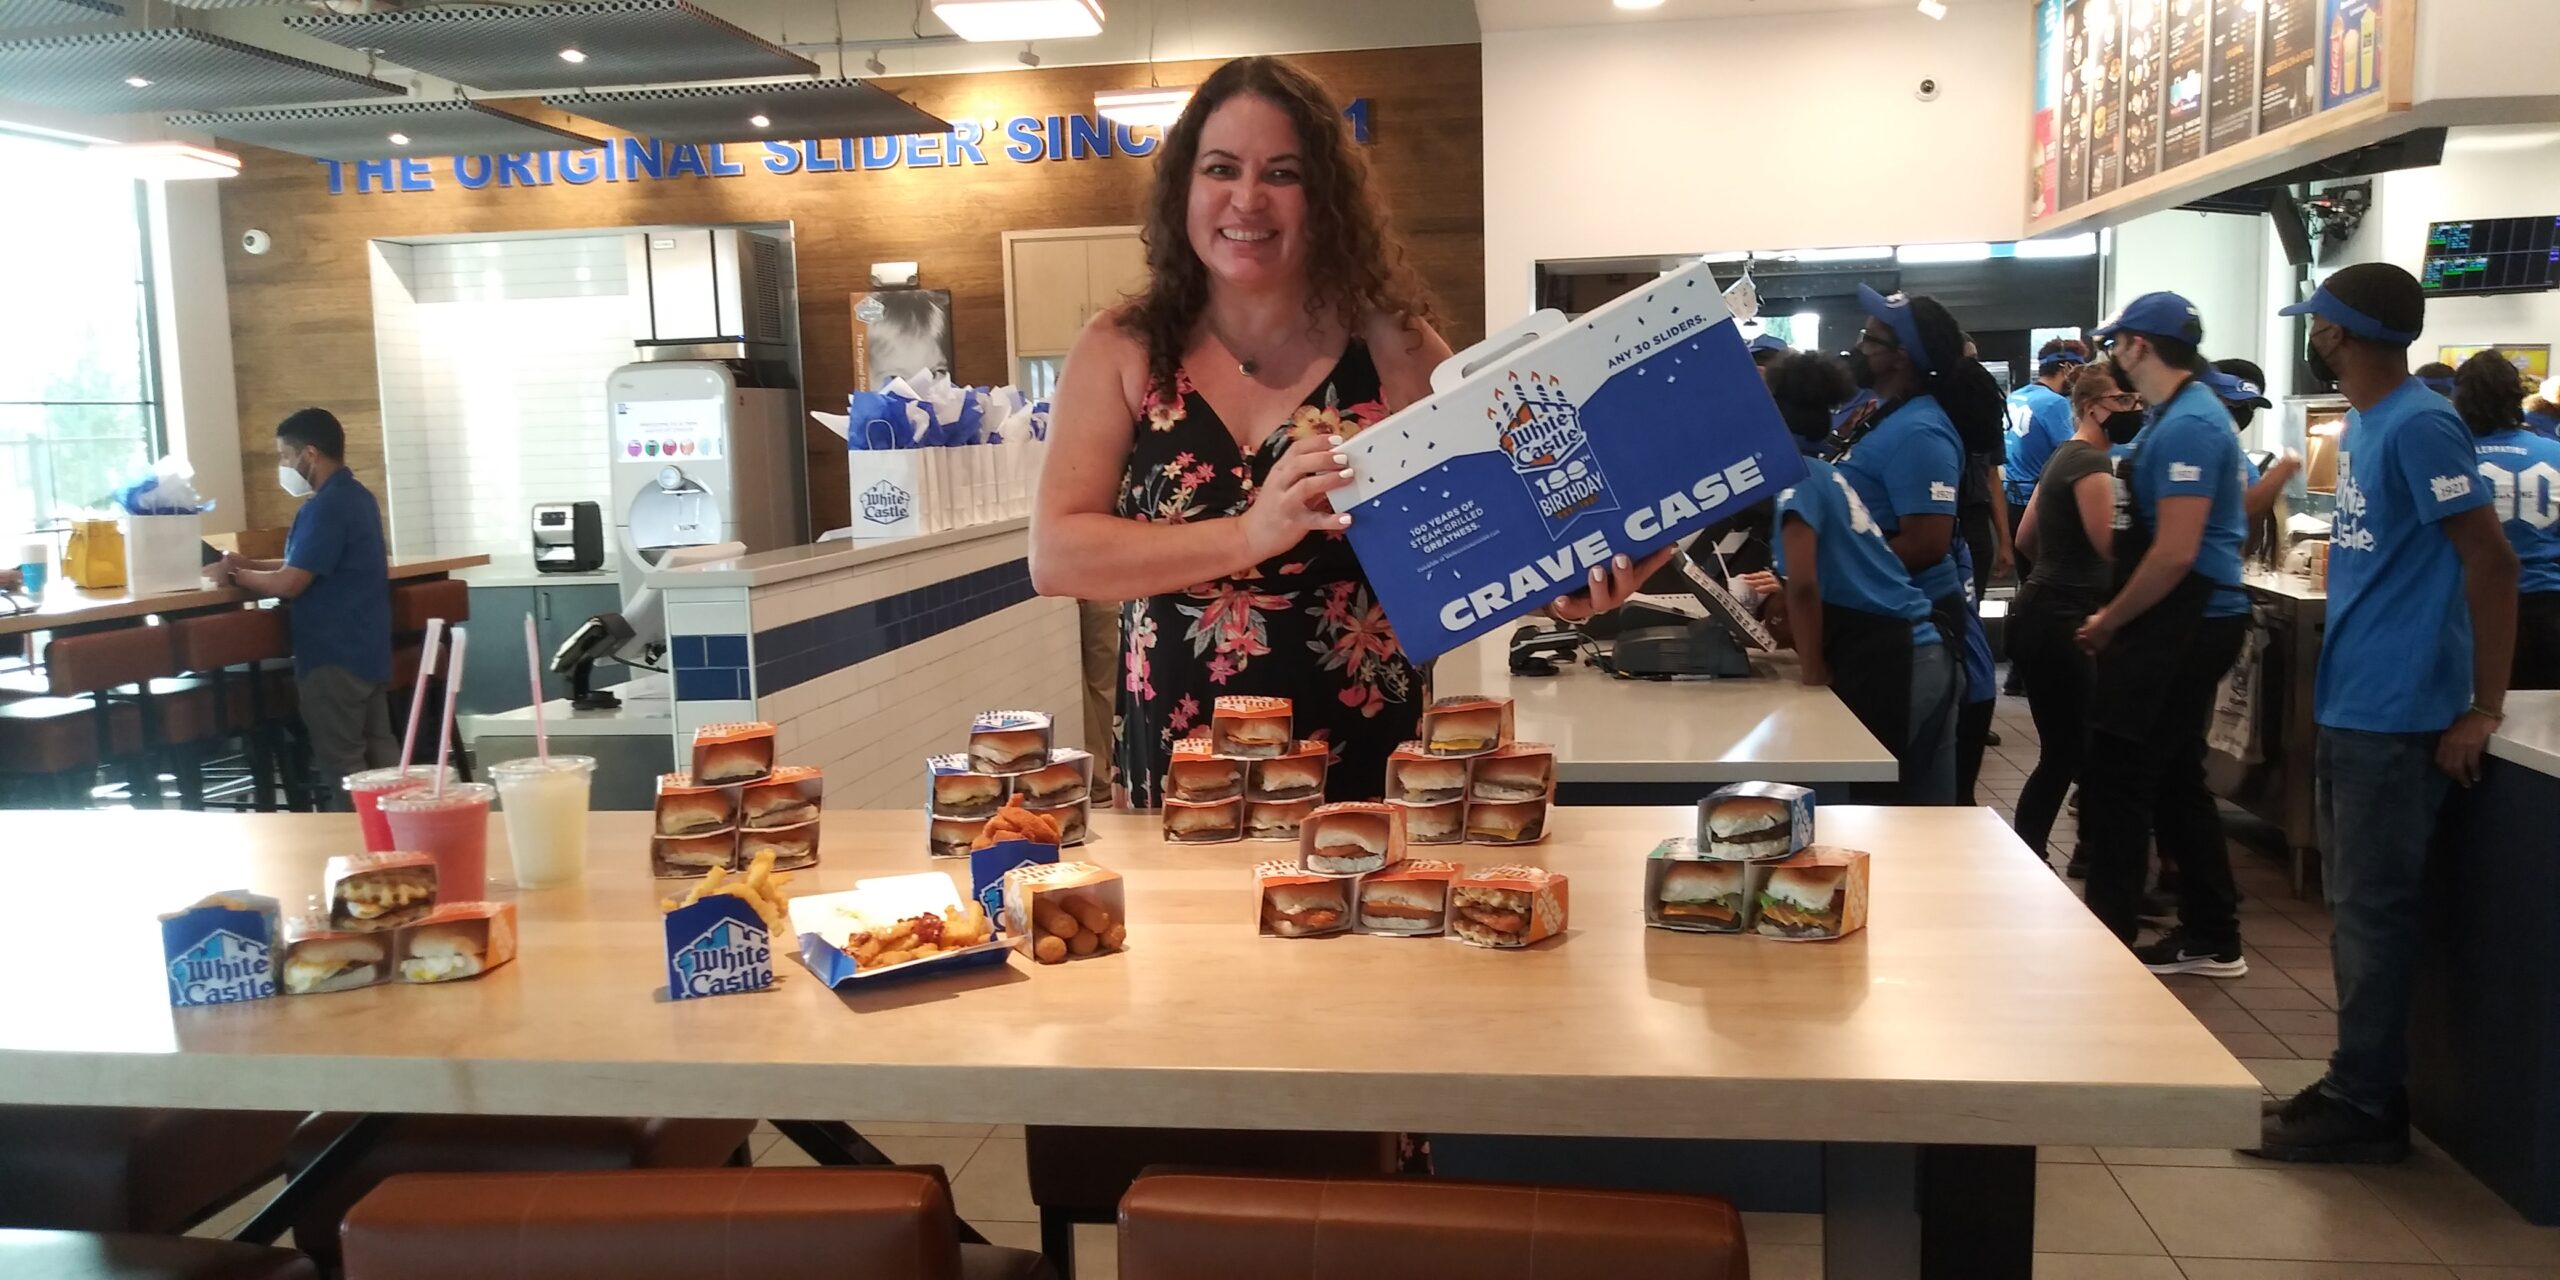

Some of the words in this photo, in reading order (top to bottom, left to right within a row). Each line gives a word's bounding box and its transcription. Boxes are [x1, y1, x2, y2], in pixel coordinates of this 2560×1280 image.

[317, 157, 436, 195] THE
[453, 137, 745, 190] ORIGINAL
[761, 121, 988, 175] SLIDER
[1005, 113, 1162, 163] SINC
[1608, 349, 1632, 370] ANY
[1634, 341, 1651, 355] 30
[1652, 314, 1707, 346] SLIDERS.
[1510, 413, 1569, 447] White
[1517, 428, 1579, 467] Castle
[864, 505, 907, 518] Castle
[866, 492, 905, 508] White
[1538, 471, 1604, 518] BIRTHDAY
[1409, 523, 1428, 537] 100
[1428, 506, 1461, 528] YEARS
[1460, 500, 1475, 513] OF
[1410, 507, 1484, 549] STEAM-GRILLED
[1423, 522, 1481, 554] GREATNESS.
[1439, 529, 1612, 632] CRAVE
[186, 957, 270, 983] White
[692, 945, 770, 973] White
[184, 978, 276, 1005] Castle
[688, 966, 772, 997] Castle
